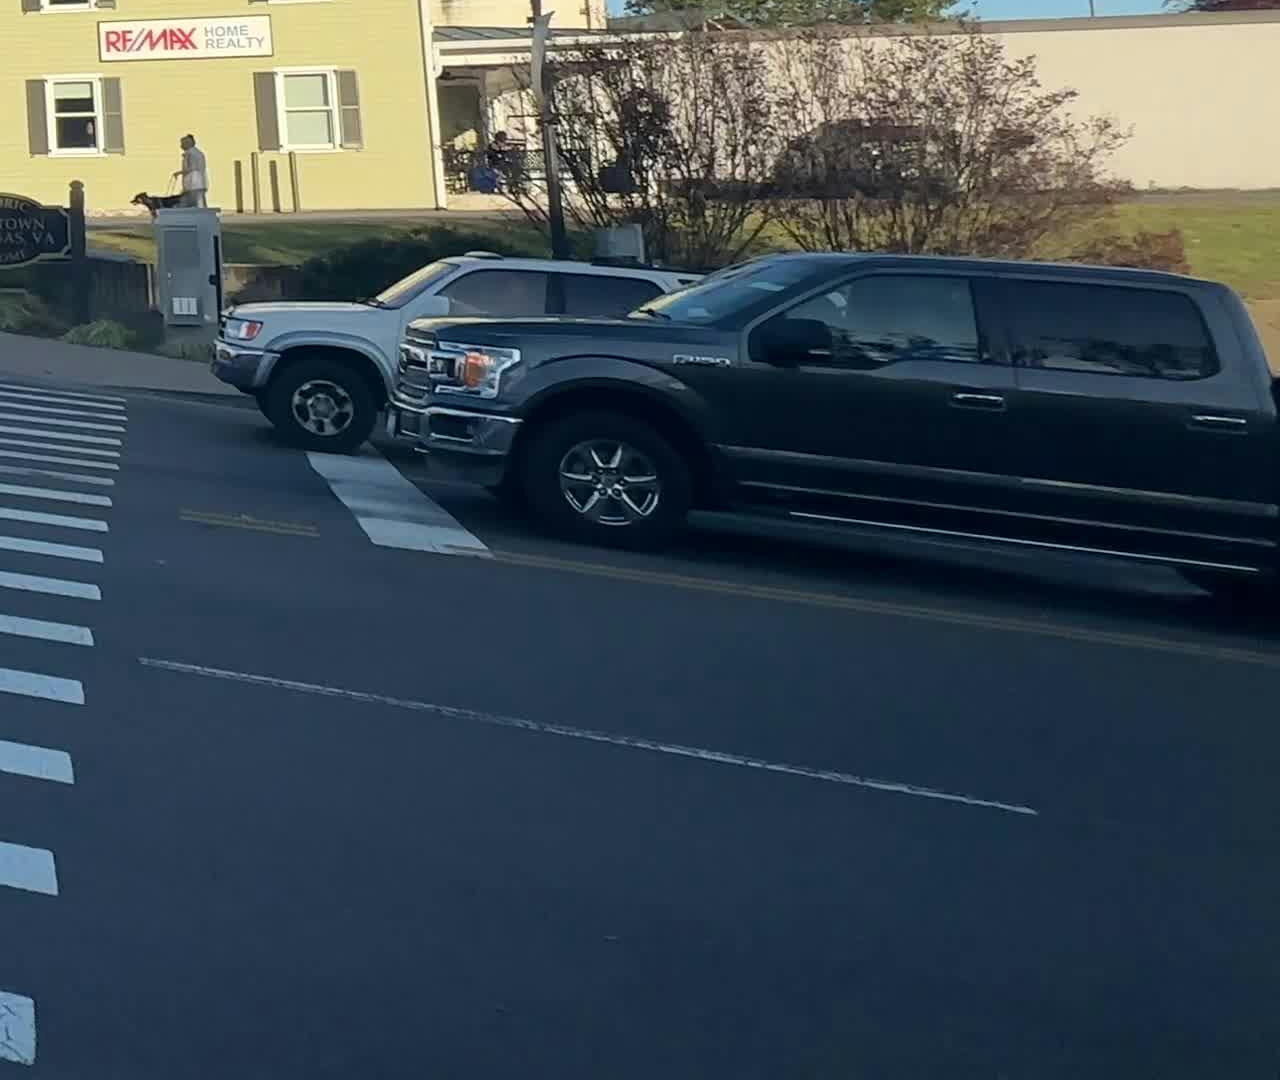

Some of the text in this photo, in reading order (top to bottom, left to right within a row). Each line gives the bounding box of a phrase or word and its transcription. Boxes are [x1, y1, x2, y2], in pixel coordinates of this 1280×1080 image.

[104, 25, 249, 52] RE/MAX HOME
[205, 36, 265, 49] REALTY
[32, 232, 55, 244] VA
